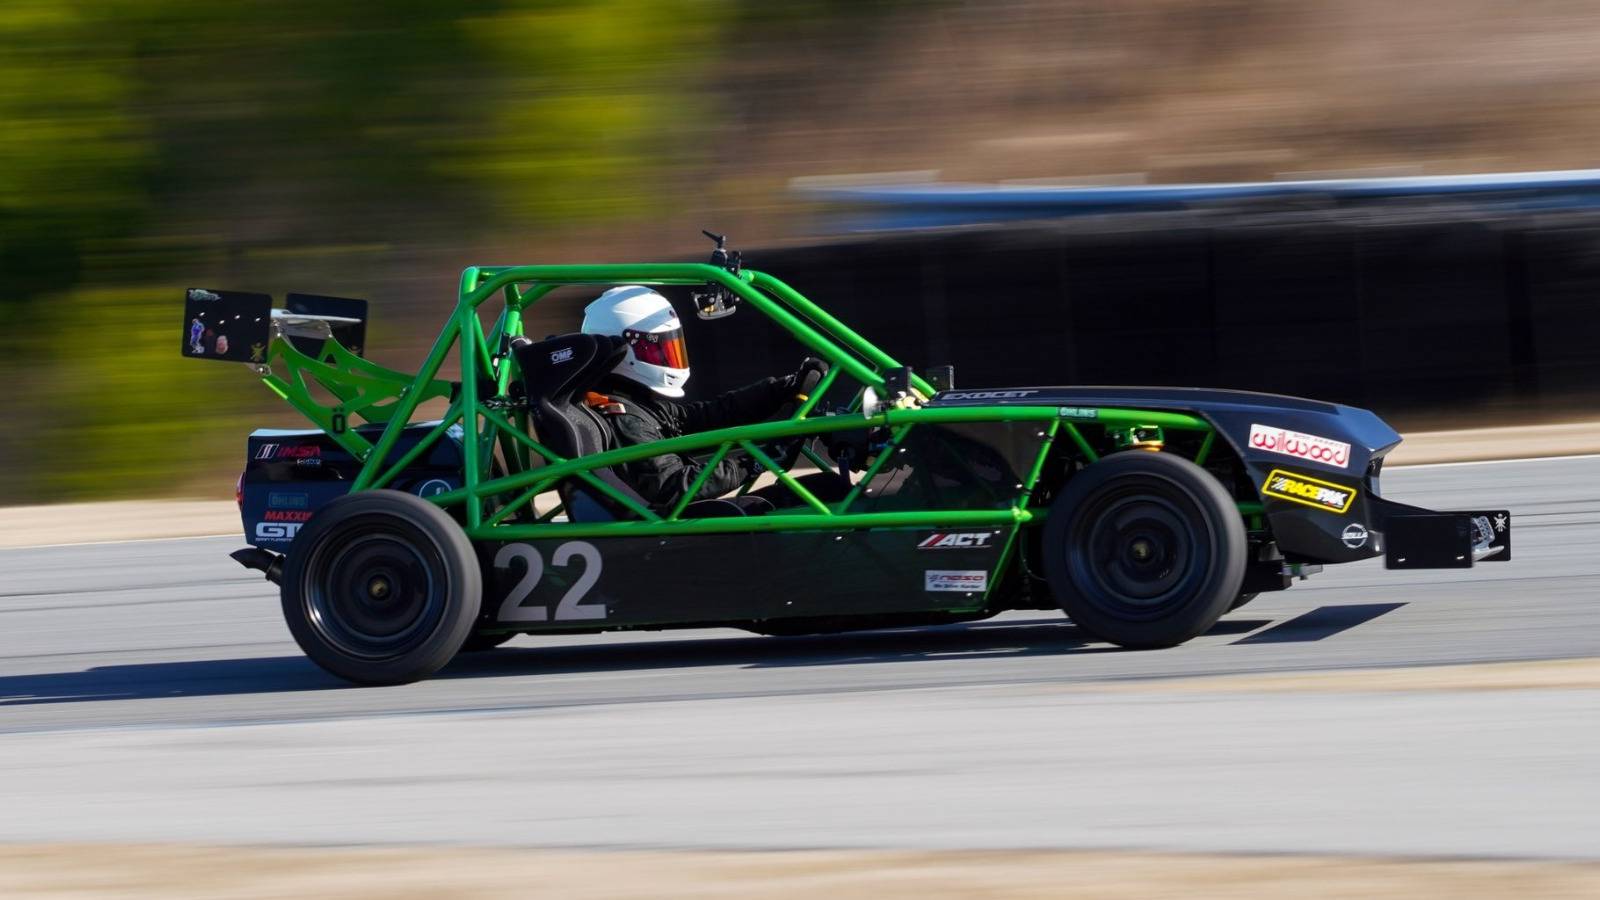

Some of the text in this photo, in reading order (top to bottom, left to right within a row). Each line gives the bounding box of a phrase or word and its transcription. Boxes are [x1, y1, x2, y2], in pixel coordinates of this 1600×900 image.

[550, 350, 573, 361] OMP
[941, 390, 1040, 400] EXOCET
[1252, 431, 1349, 465] wilwood
[1284, 479, 1348, 506] RACEPAK
[934, 533, 992, 546] ACT
[493, 540, 607, 622] 22
